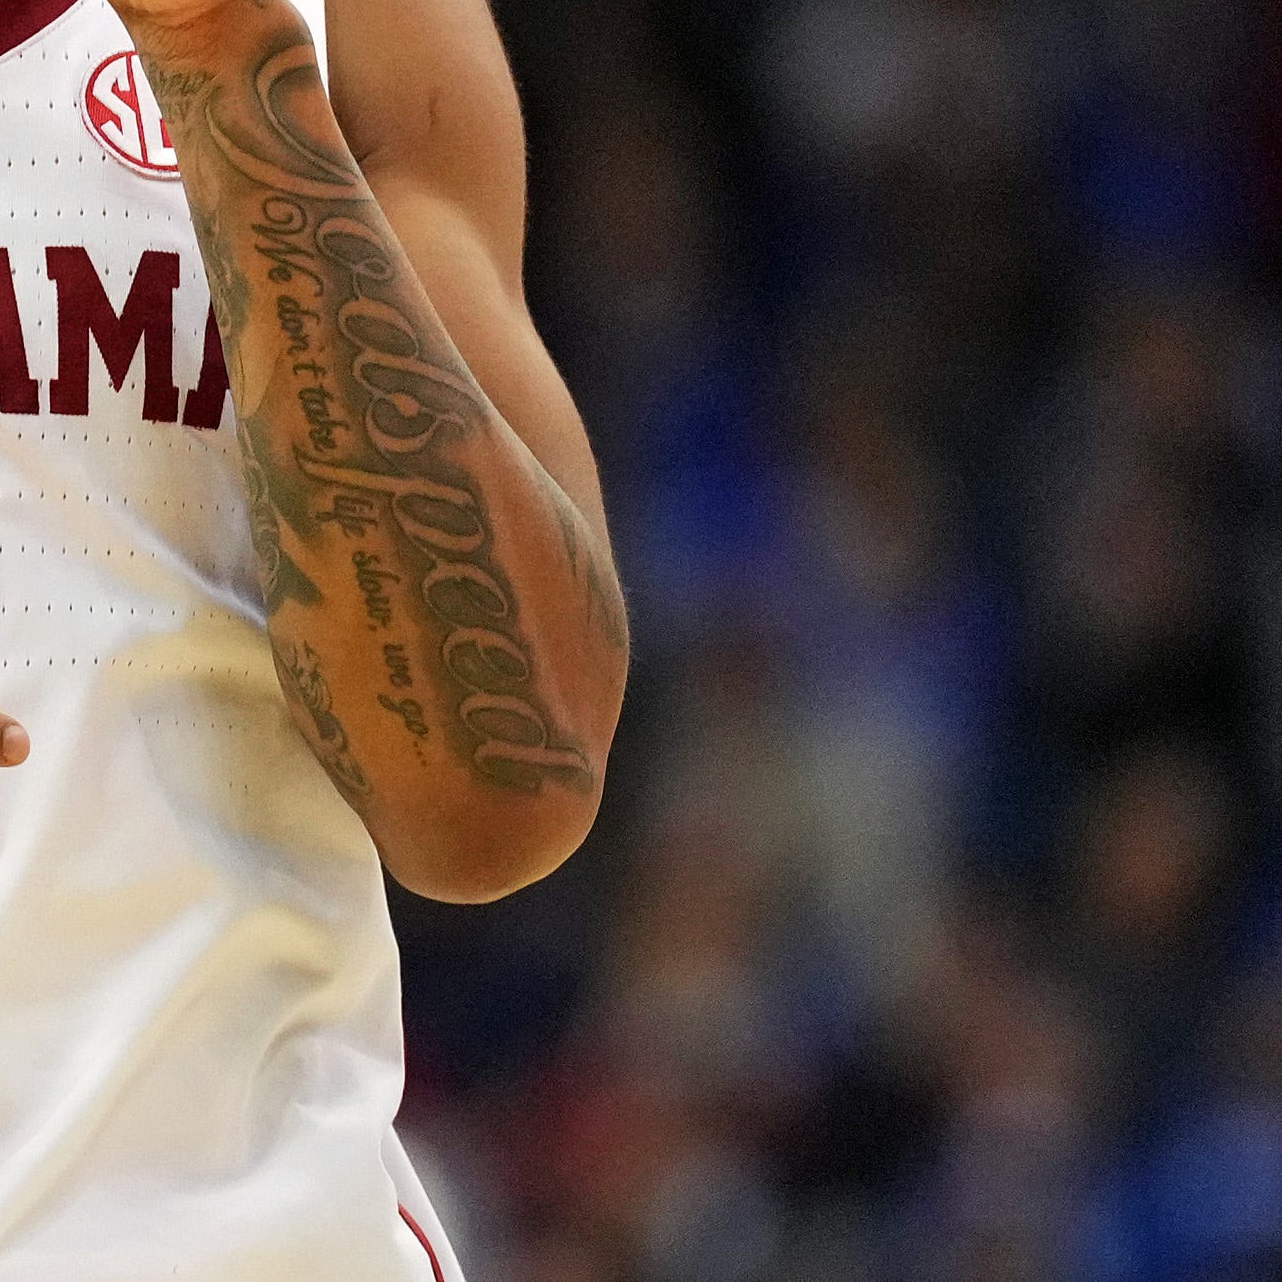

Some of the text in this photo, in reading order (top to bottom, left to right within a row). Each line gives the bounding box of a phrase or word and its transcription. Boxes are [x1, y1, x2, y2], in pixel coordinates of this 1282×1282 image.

[251, 195, 325, 298] We
[276, 295, 327, 377] don't
[297, 385, 350, 452] take
[315, 494, 379, 539] life
[383, 642, 413, 689] we
